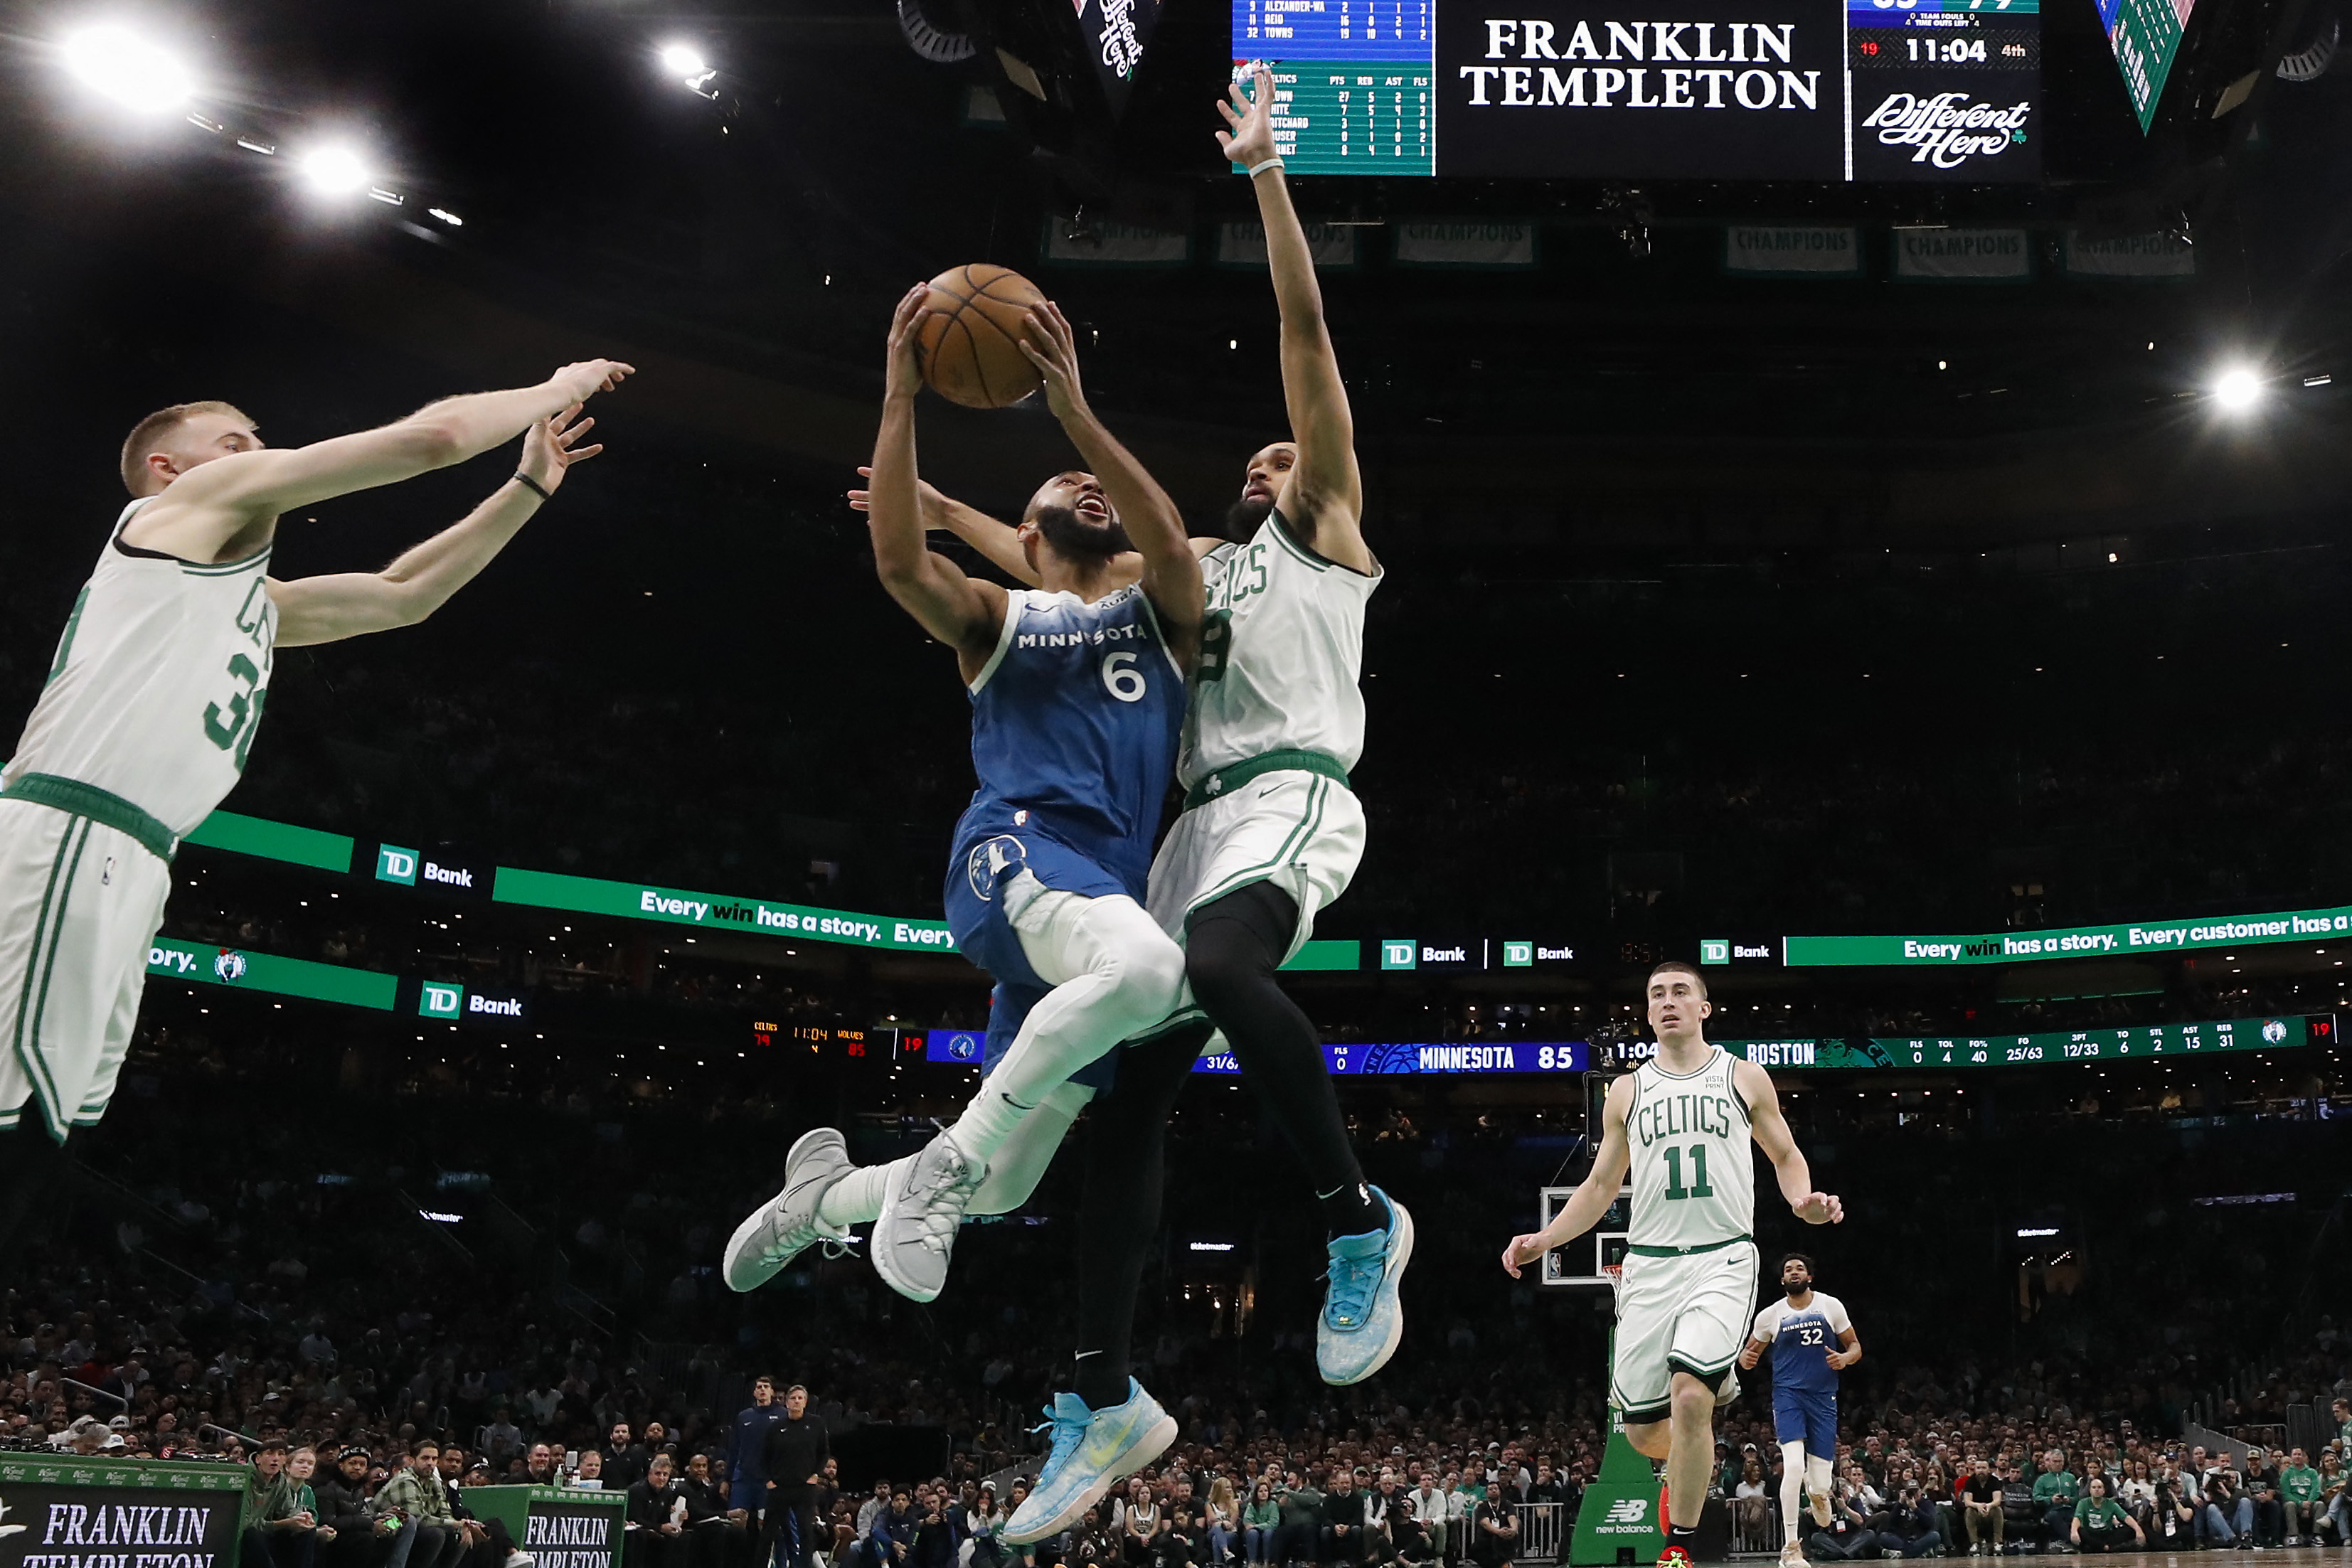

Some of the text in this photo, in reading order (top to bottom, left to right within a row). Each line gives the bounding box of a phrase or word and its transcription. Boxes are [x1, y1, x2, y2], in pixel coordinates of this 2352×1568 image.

[1250, 0, 1426, 15] 9 ALEXANDER-WA 2 1 1 3
[1249, 14, 1425, 28] 11 REID 16 8 2 1
[1247, 26, 1427, 41] 32 TOWNS 19 10 4 2
[1484, 19, 1795, 63] FRANKLIN
[1861, 38, 2026, 63] 19 11:04 4th
[1270, 74, 1427, 86] ELTICS PTS REB AST FLS
[1459, 65, 1821, 110] TEMPLETON
[1250, 90, 1426, 103] 7 OWN 27 5 2 0
[1271, 104, 1426, 117] HITE 7 5 4 3
[1862, 92, 2031, 129] Different
[1270, 117, 1426, 130] RITCHARD 3 1 1 0
[1272, 131, 1426, 143] USER 0 1 0 2
[1275, 144, 1425, 157] RNET 8 4 0 1
[1879, 128, 2011, 169] Here
[1231, 222, 1346, 242] CHAONS
[1409, 223, 1524, 242] CHAMPIONS
[1736, 231, 1849, 252] CHAMPIONS
[1906, 235, 2021, 257] CHAMPIONS
[1102, 651, 1146, 703] 6
[383, 850, 472, 888] TD Bank
[640, 890, 956, 948] Every win has a story. Every
[2129, 928, 2188, 949] Every
[2190, 920, 2289, 942] customer
[2292, 915, 2331, 934] has
[2334, 915, 2348, 930] a
[1385, 944, 1465, 964] TD Bank
[1506, 945, 1573, 962] TD Bank
[1703, 944, 1770, 961] TD Bank
[1904, 932, 2118, 961] Every win has a story.
[148, 946, 198, 973] ory.
[425, 987, 523, 1017] TD Bank
[754, 1021, 864, 1040] CELTICS WOLVES
[794, 1027, 828, 1041] 11:04
[2149, 1028, 2163, 1037] STL
[2182, 1025, 2198, 1035] AST
[2216, 1023, 2232, 1033] REB
[2312, 1023, 2330, 1036] 19
[754, 1033, 770, 1046] 79
[904, 1036, 922, 1051] 19
[1969, 1040, 1988, 1048] FG%
[2072, 1033, 2087, 1041] 3PT
[2154, 1038, 2162, 1051] 2
[2184, 1036, 2200, 1049] 15
[2219, 1034, 2234, 1047] 31
[1747, 1042, 1815, 1065] BOSTON
[2006, 1047, 2043, 1061] 25/63
[2063, 1042, 2099, 1057] 12/33
[2119, 1040, 2129, 1053] 6
[1337, 1057, 1346, 1070] 0
[1420, 1046, 1573, 1070] MINNESOTA 85
[1913, 1050, 1988, 1063] 0 4 40
[1638, 1094, 1730, 1147] CELTICS
[1663, 1143, 1713, 1200] 11
[1782, 1320, 1822, 1333] MINNESOTA
[1799, 1328, 1824, 1346] 32
[42, 1503, 211, 1546] FRANKLIN
[525, 1515, 610, 1546] FRANKLIN
[1616, 1524, 1654, 1534] balance
